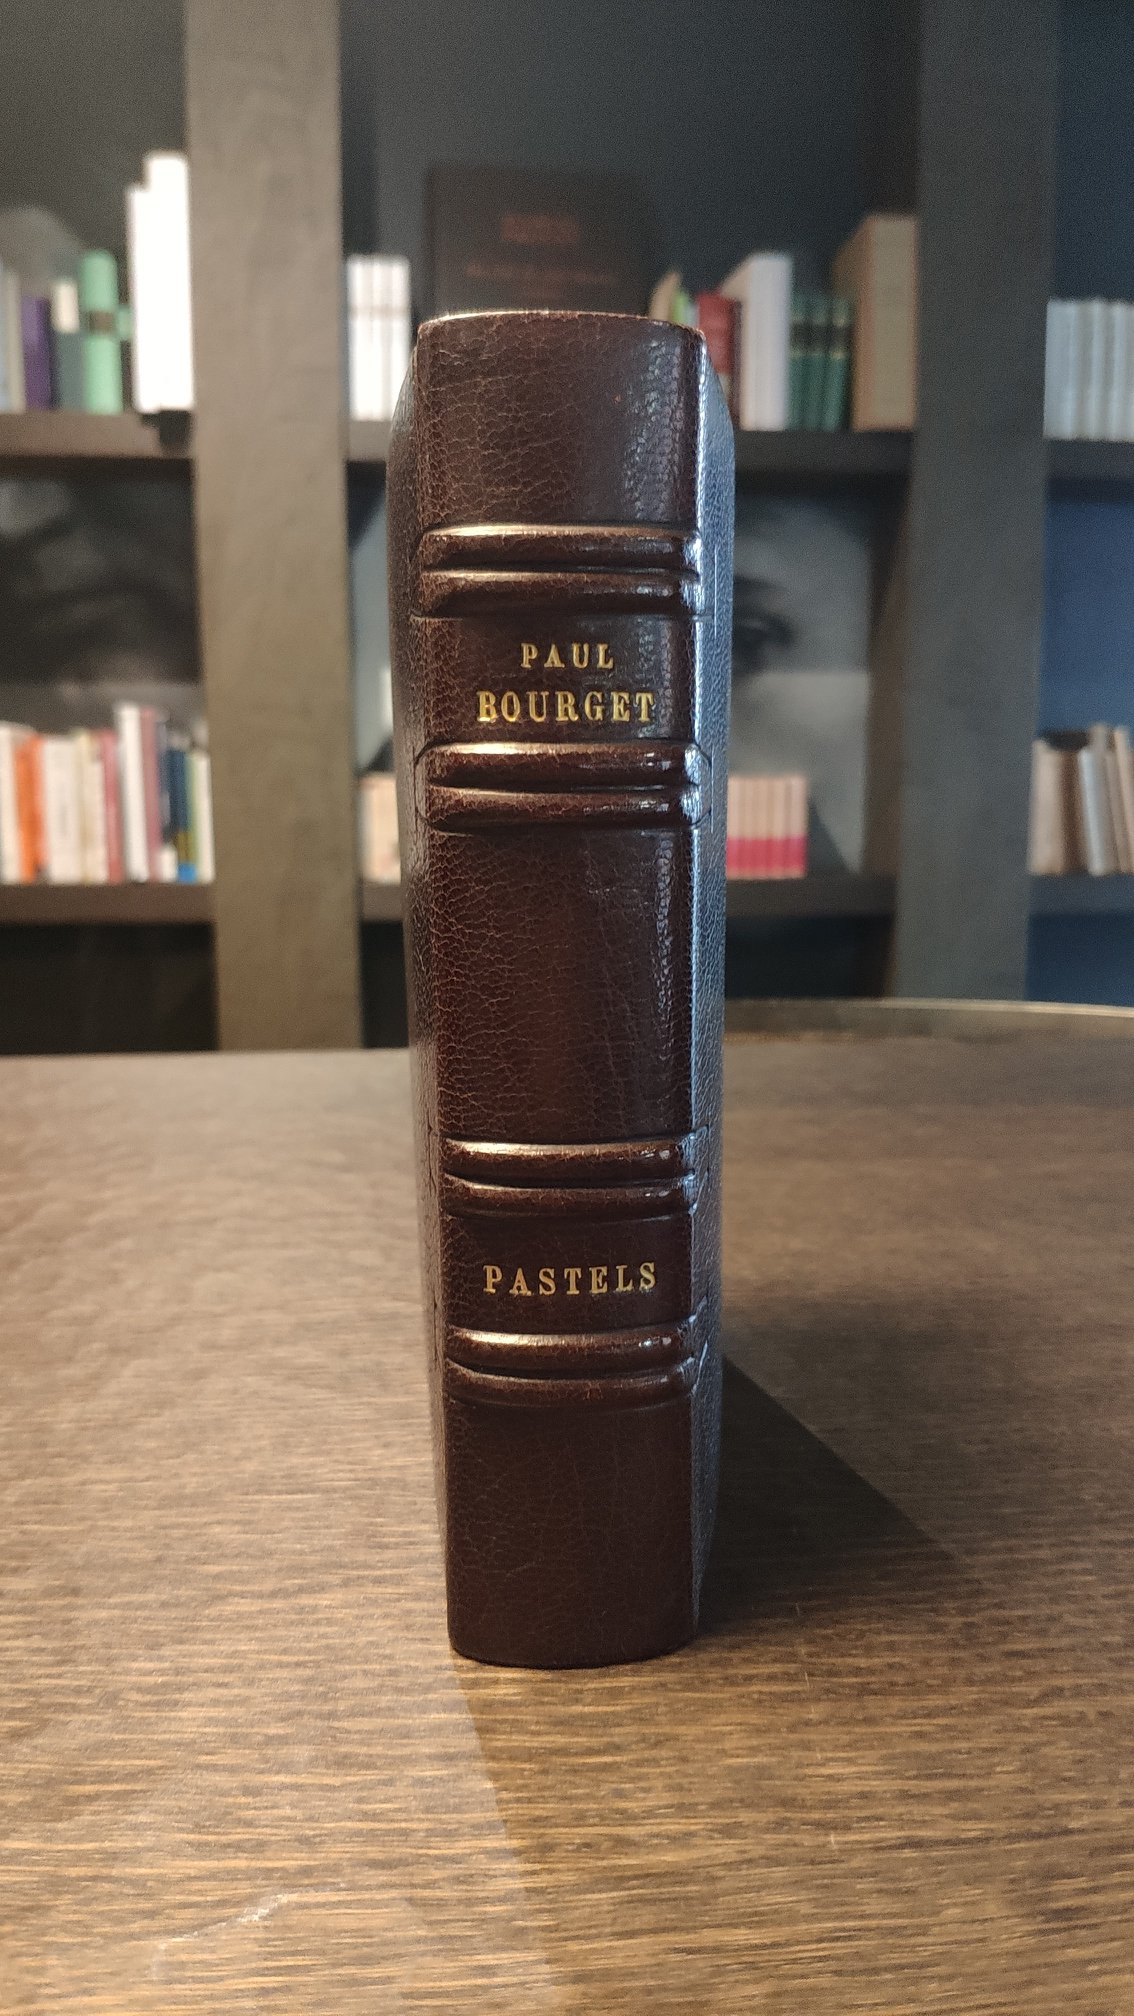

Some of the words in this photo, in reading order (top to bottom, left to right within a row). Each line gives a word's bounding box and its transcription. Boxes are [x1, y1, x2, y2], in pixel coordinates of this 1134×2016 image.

[520, 642, 615, 669] PAUL
[476, 690, 656, 723] BOURGET
[482, 1261, 657, 1297] PASTELS
